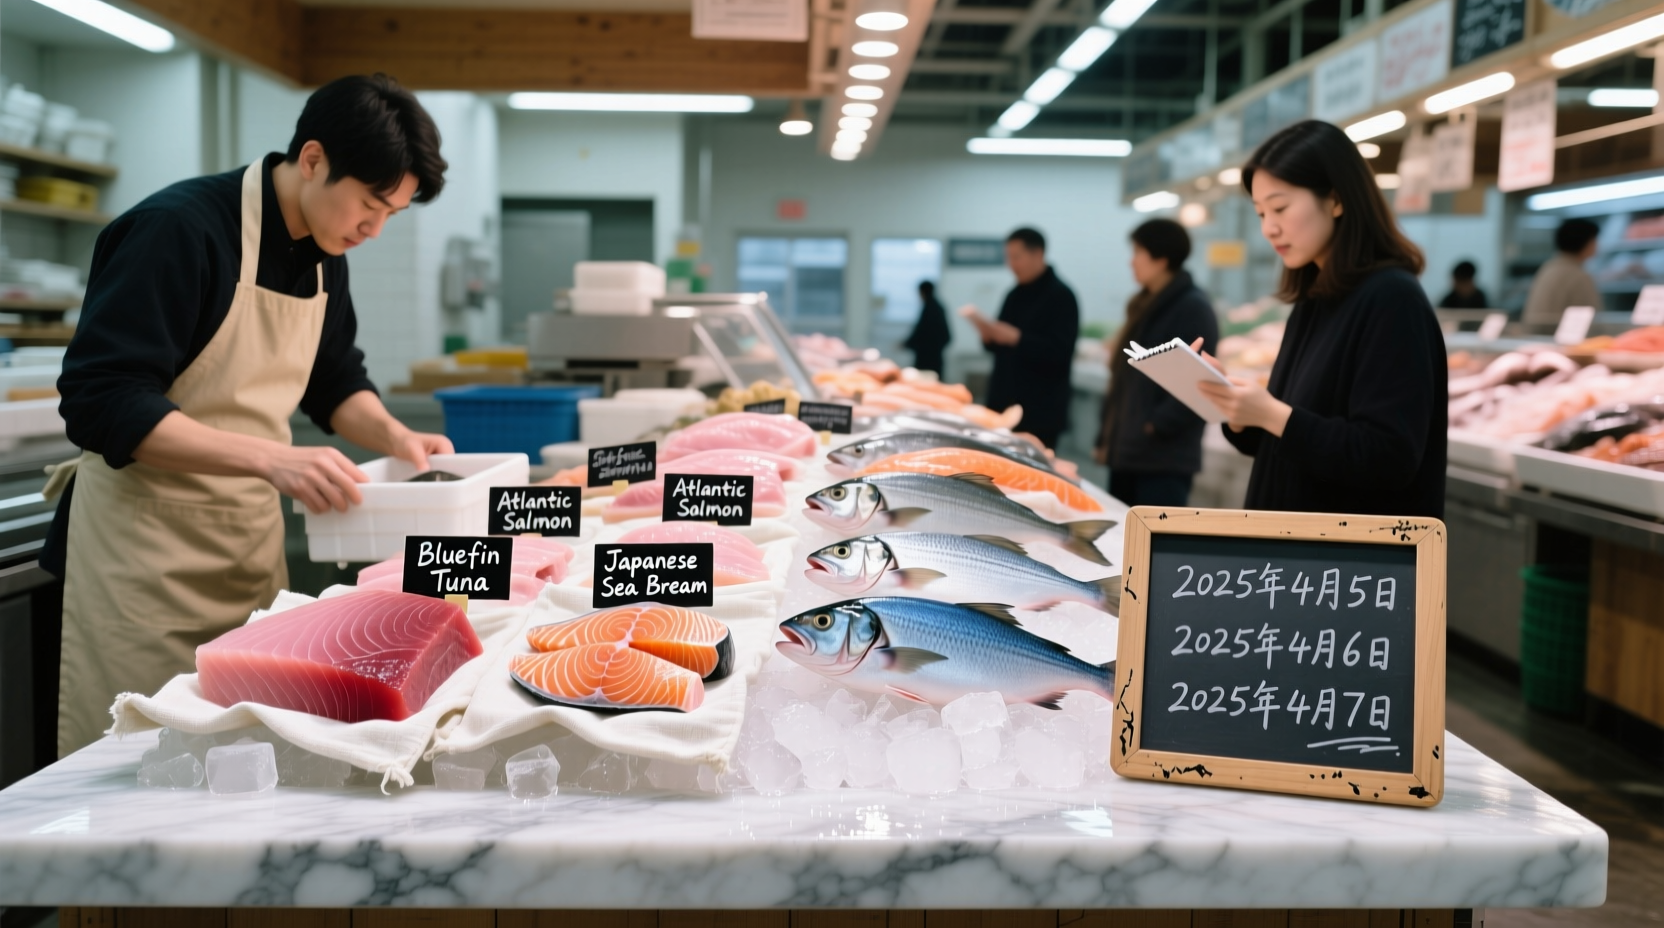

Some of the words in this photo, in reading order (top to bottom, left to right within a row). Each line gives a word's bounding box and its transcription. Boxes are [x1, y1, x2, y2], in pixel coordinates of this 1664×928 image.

[673, 477, 746, 498] Atlantic
[496, 490, 572, 511] Atlantic
[677, 498, 743, 517] Salmon
[502, 511, 572, 531] Salmon
[417, 541, 500, 569] Bluefin
[603, 548, 698, 578] Japanese
[430, 569, 490, 593] Tuna
[600, 576, 639, 598] Sea
[646, 575, 707, 596] Bream
[1171, 562, 1397, 611] 2025年4月5日
[1170, 622, 1390, 671] 2025年4月6日
[1167, 679, 1391, 731] 2025年4月7日
